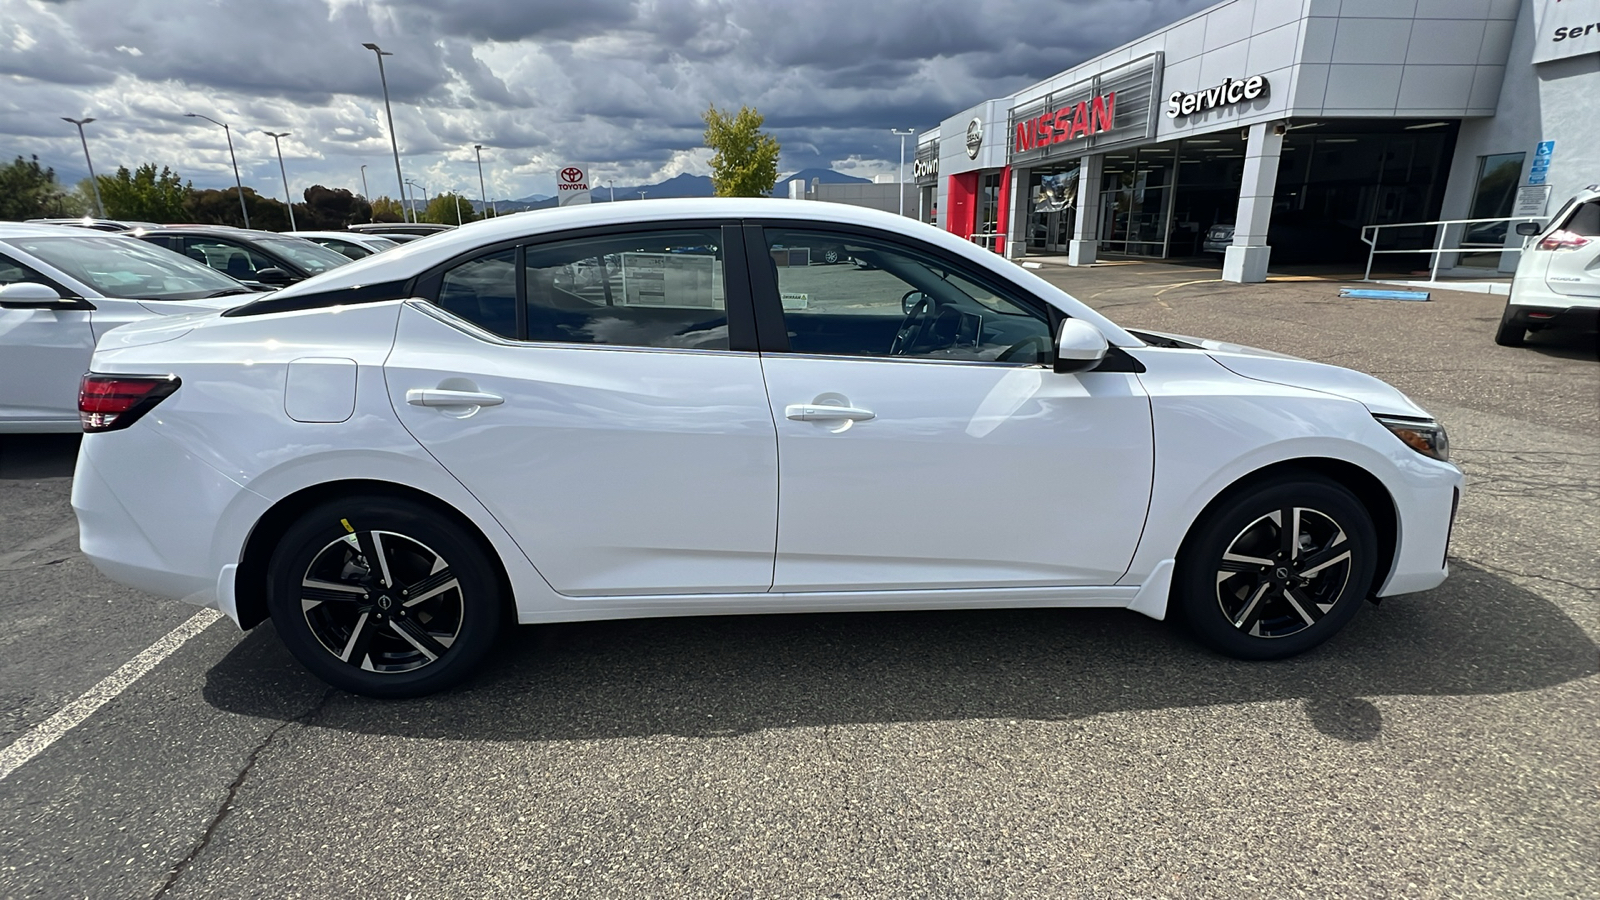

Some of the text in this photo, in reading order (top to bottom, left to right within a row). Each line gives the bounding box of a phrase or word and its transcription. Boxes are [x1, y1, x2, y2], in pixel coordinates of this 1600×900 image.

[1166, 75, 1263, 119] Service
[1016, 92, 1115, 153] NISSAN
[914, 158, 939, 177] Crown
